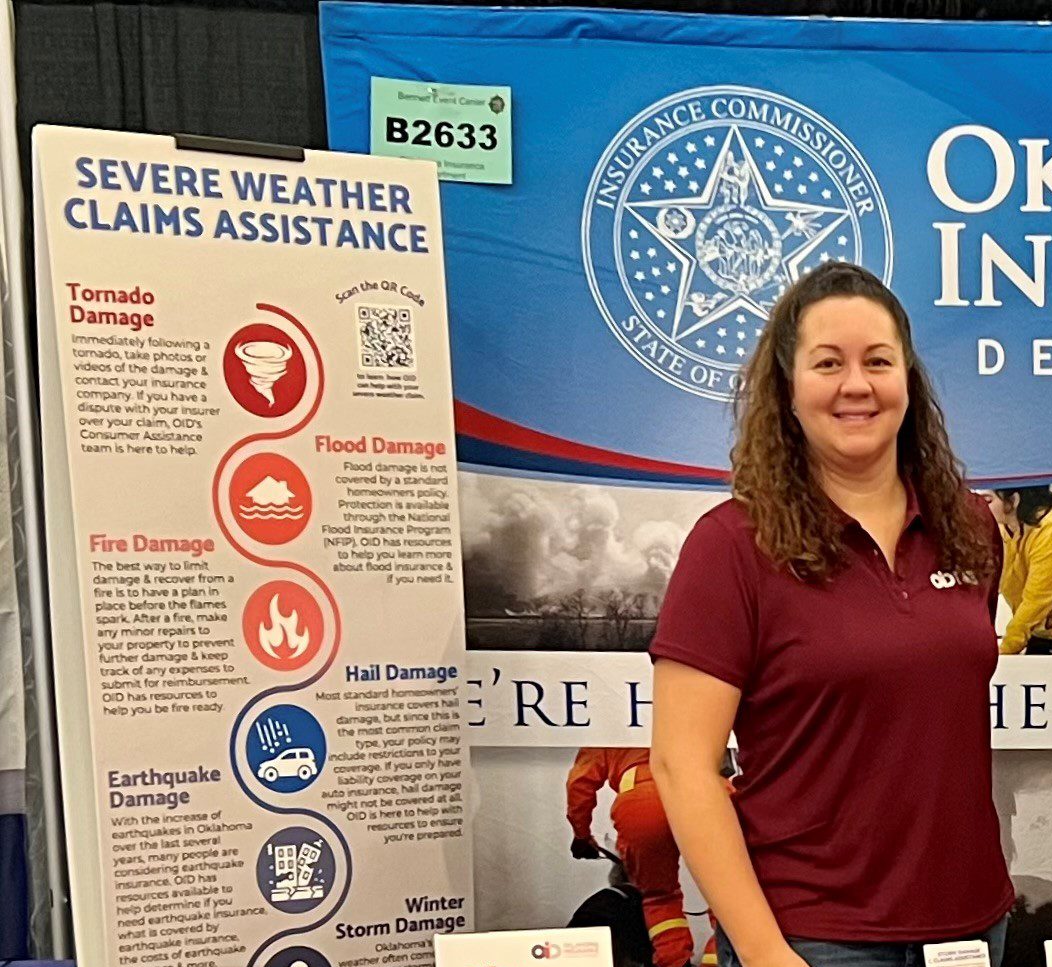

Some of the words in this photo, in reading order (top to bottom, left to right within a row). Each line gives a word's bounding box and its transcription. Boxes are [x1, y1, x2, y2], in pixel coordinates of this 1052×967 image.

[386, 117, 498, 150] B2633
[597, 100, 706, 209] INSURANCE
[711, 97, 874, 217] COMMISSIONER
[75, 157, 223, 198] SEVERE
[230, 170, 412, 214] WEATHER
[64, 198, 204, 238] CLAIMS
[213, 210, 429, 254] ASSISTANCE
[66, 283, 154, 305] Tornado
[335, 286, 359, 304] Scan
[360, 280, 378, 292] the
[381, 281, 398, 293] QR
[400, 286, 426, 307] Code
[70, 305, 154, 331] Damage
[124, 349, 150, 360] take
[152, 350, 192, 362] photos
[621, 314, 683, 376] STATE
[690, 366, 721, 387] OF
[74, 361, 111, 372] videos
[114, 362, 125, 372] of
[128, 363, 147, 373] the
[150, 363, 197, 377] damage
[200, 365, 209, 375] &
[74, 376, 119, 386] contact
[122, 379, 147, 389] your
[150, 377, 207, 388] insurance
[80, 429, 139, 440] Consumer
[143, 430, 203, 441] Assistance
[315, 435, 367, 454] Flood
[372, 437, 446, 459] Damage
[90, 534, 128, 552] Fire
[133, 535, 215, 557] Damage
[95, 600, 125, 612] place
[127, 600, 165, 610] before
[167, 599, 187, 609] the
[189, 599, 227, 609] flames
[98, 642, 123, 652] your
[126, 639, 175, 651] property
[177, 638, 189, 648] to
[191, 638, 235, 650] prevent
[346, 664, 380, 682] Hail
[386, 664, 458, 683] Damage
[108, 766, 221, 788] Earthquake
[110, 789, 190, 810] Damage
[111, 826, 181, 839] earthquakes
[183, 825, 194, 834] in
[196, 822, 253, 833] Oklahoma
[114, 864, 179, 877] considering
[181, 859, 244, 873] earthquake
[405, 896, 465, 913] Winter
[336, 923, 390, 939] Storm
[396, 916, 465, 933] Damage
